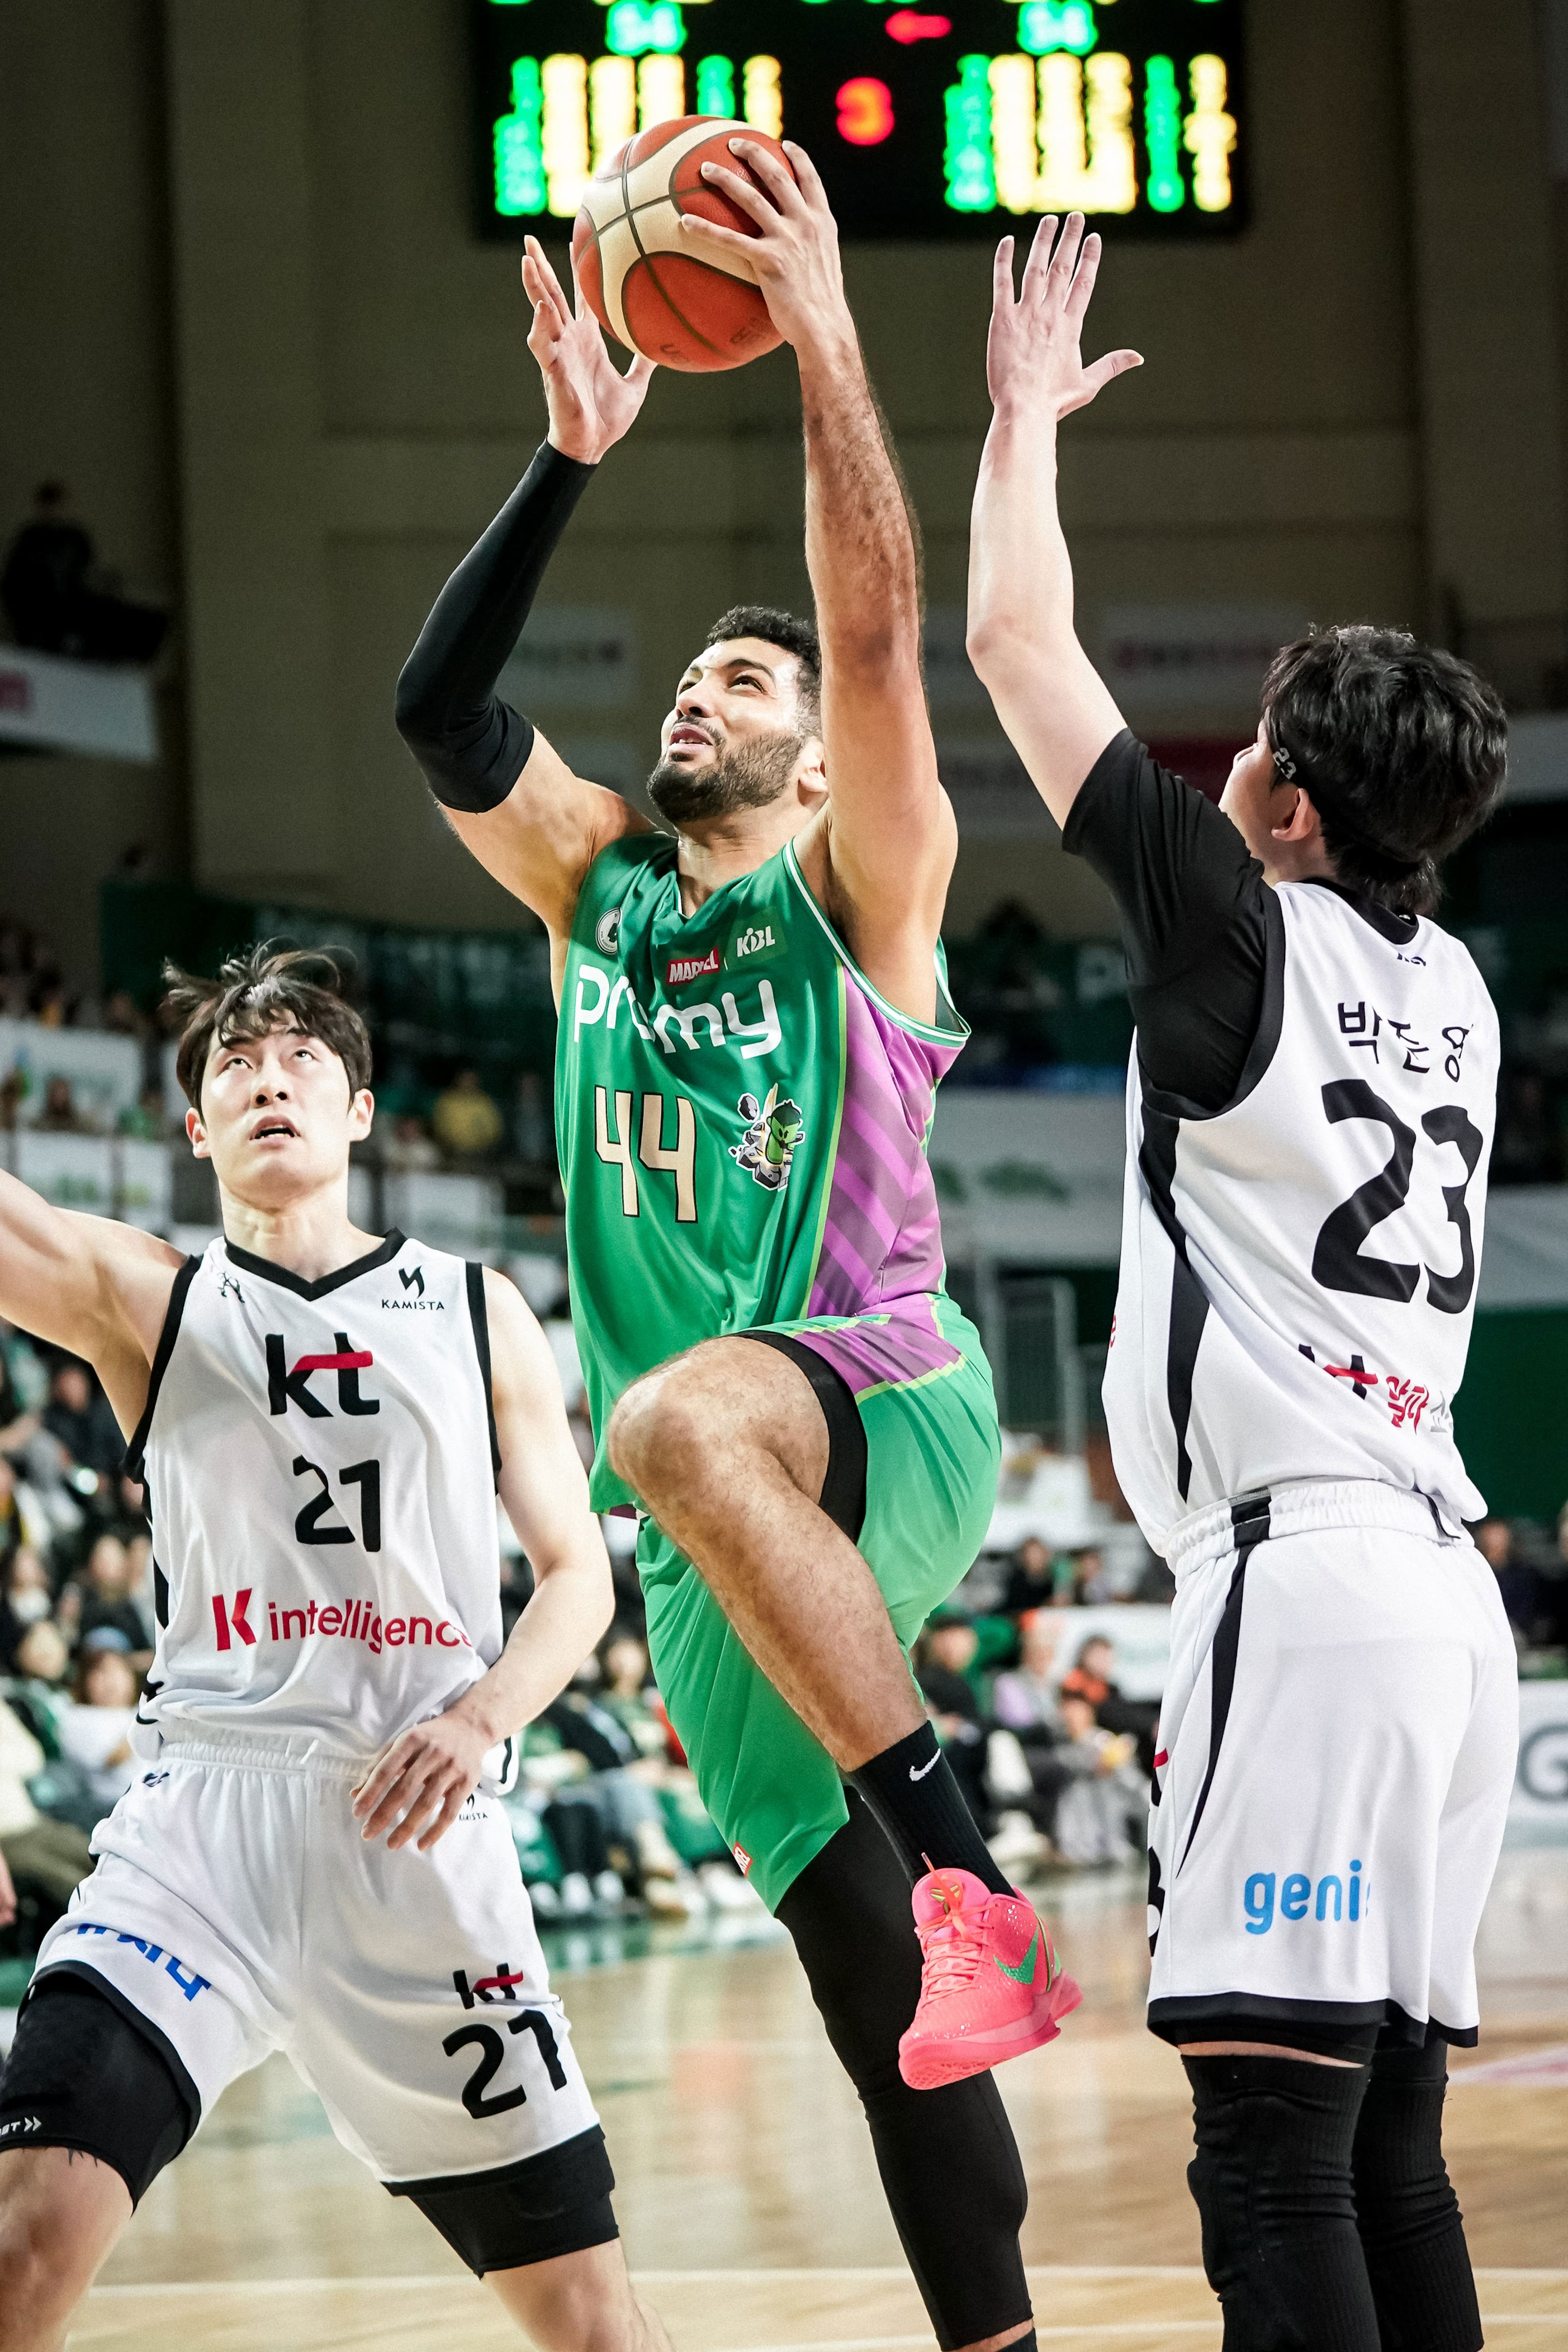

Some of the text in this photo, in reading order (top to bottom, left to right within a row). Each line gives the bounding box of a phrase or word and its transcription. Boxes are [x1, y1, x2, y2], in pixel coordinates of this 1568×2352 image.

[1272, 747, 1296, 779] 23
[595, 1085, 698, 1223] 44
[1311, 1078, 1483, 1314] 23
[382, 1299, 445, 1310] KAMISTA
[265, 1332, 380, 1418] kt
[292, 1455, 381, 1553] 21
[212, 1588, 257, 1651] K
[1244, 1859, 1371, 1935] geni
[442, 2009, 567, 2119] 21
